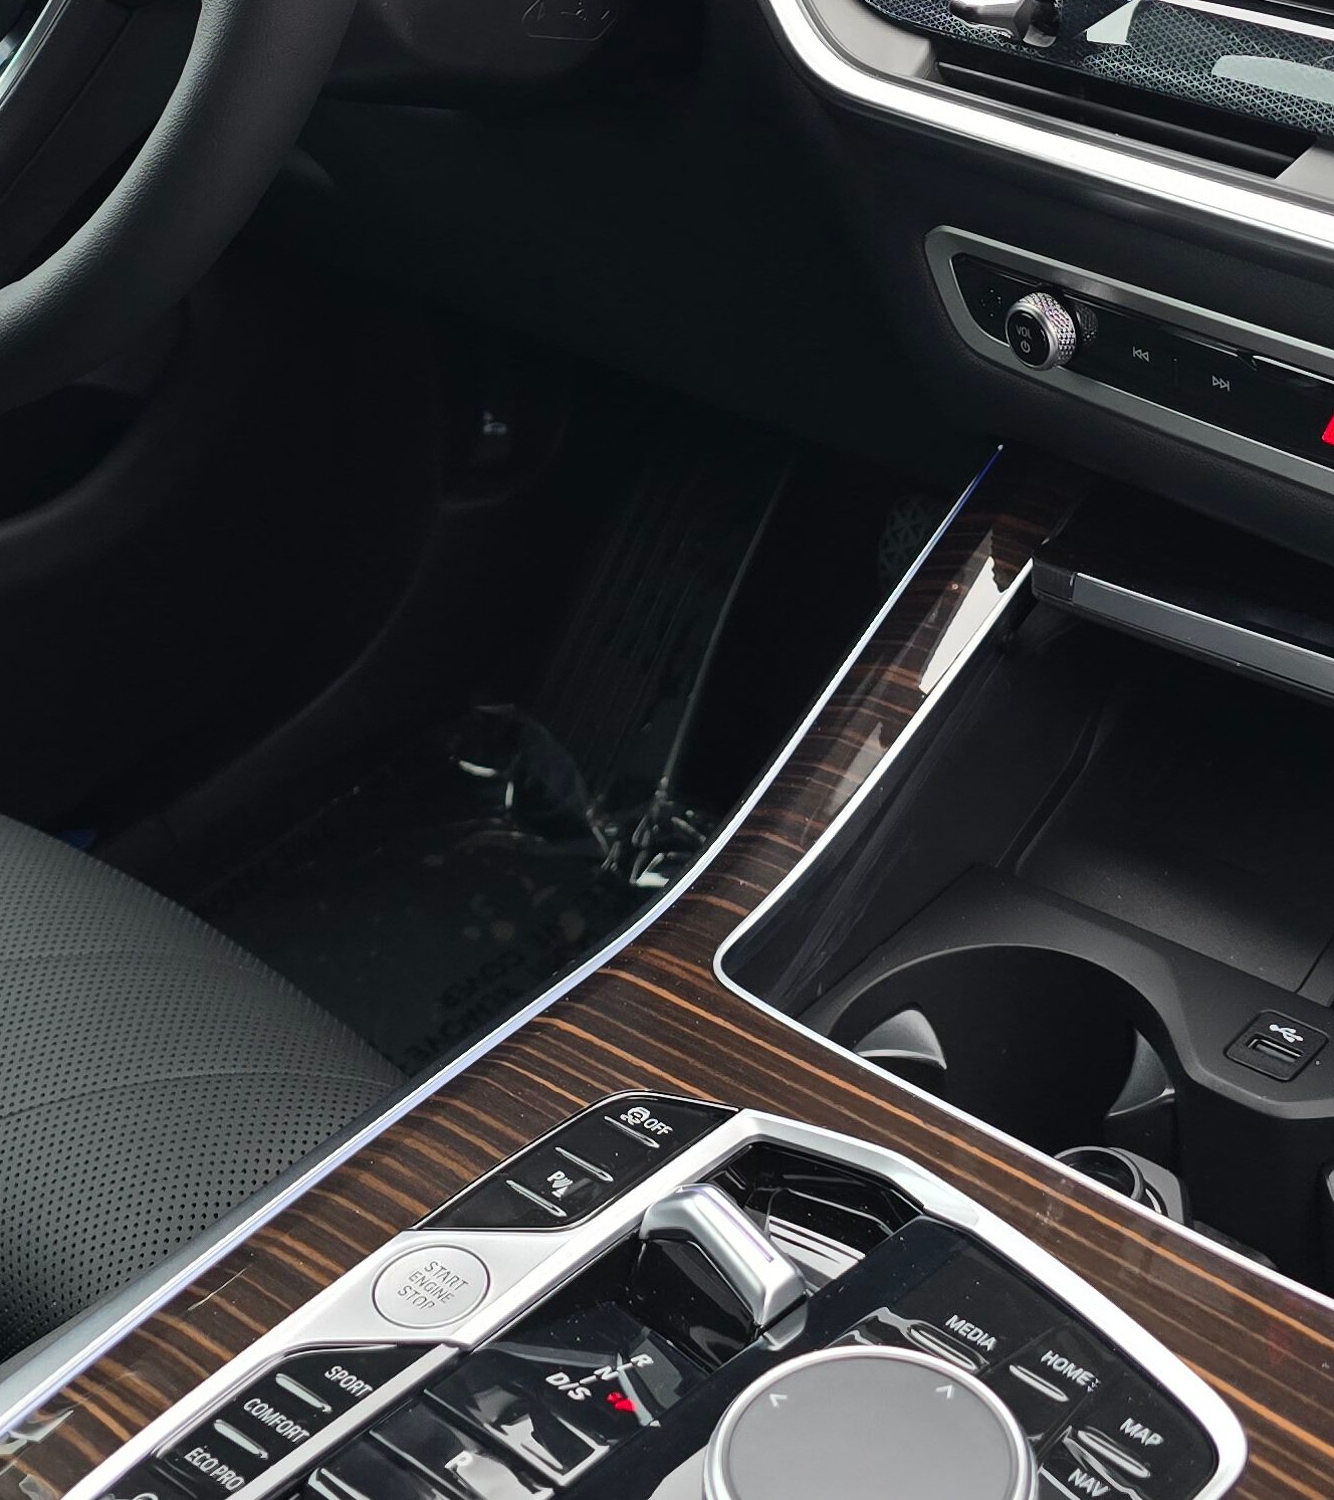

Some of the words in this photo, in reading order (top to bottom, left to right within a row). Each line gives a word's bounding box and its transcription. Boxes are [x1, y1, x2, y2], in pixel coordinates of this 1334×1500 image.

[1015, 324, 1033, 341] VOL
[643, 1118, 673, 1136] OFF
[408, 1270, 455, 1304] ENGINE
[424, 1260, 469, 1291] START
[397, 1285, 436, 1310] STOP
[944, 1314, 997, 1352] MEDIA
[631, 1353, 655, 1369] R
[1040, 1350, 1093, 1388] HOME
[324, 1365, 375, 1400] SPORT
[545, 1372, 592, 1402] D/S
[242, 1397, 312, 1445] COMFORT
[1119, 1417, 1165, 1447] MAP
[183, 1446, 218, 1473] ECO
[209, 1464, 247, 1493] PRO
[1067, 1467, 1110, 1498] NAV
